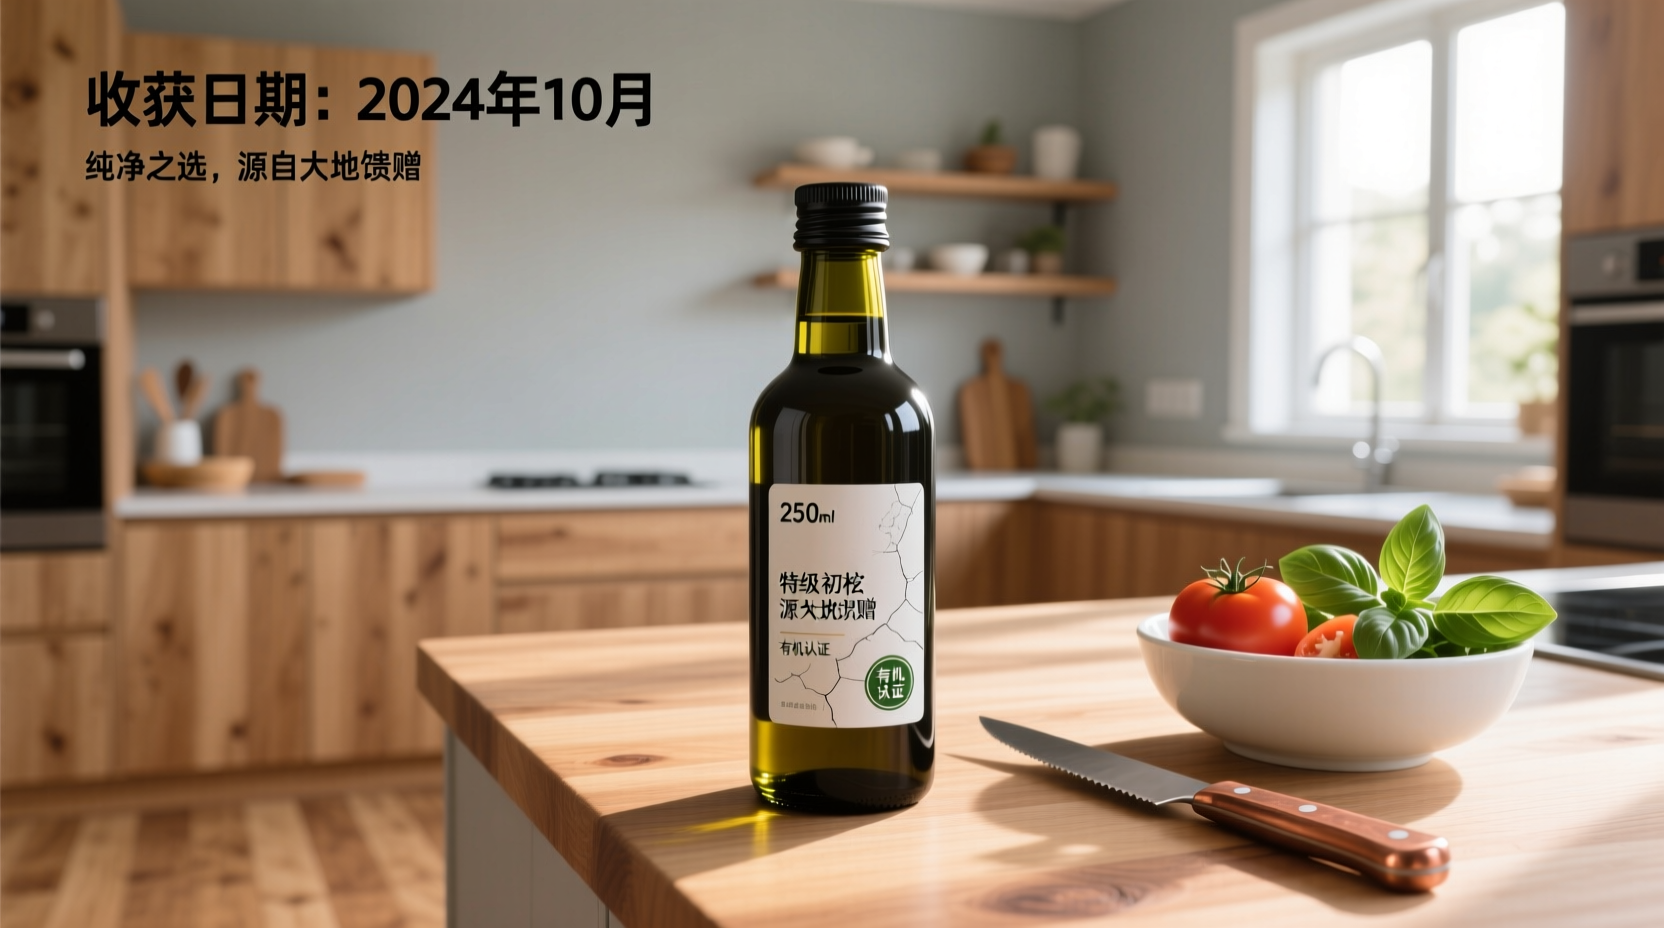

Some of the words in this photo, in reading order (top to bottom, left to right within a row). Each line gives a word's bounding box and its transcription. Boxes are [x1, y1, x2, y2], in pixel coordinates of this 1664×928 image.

[780, 502, 835, 523] 250ml
[779, 640, 831, 656] 有机认证
